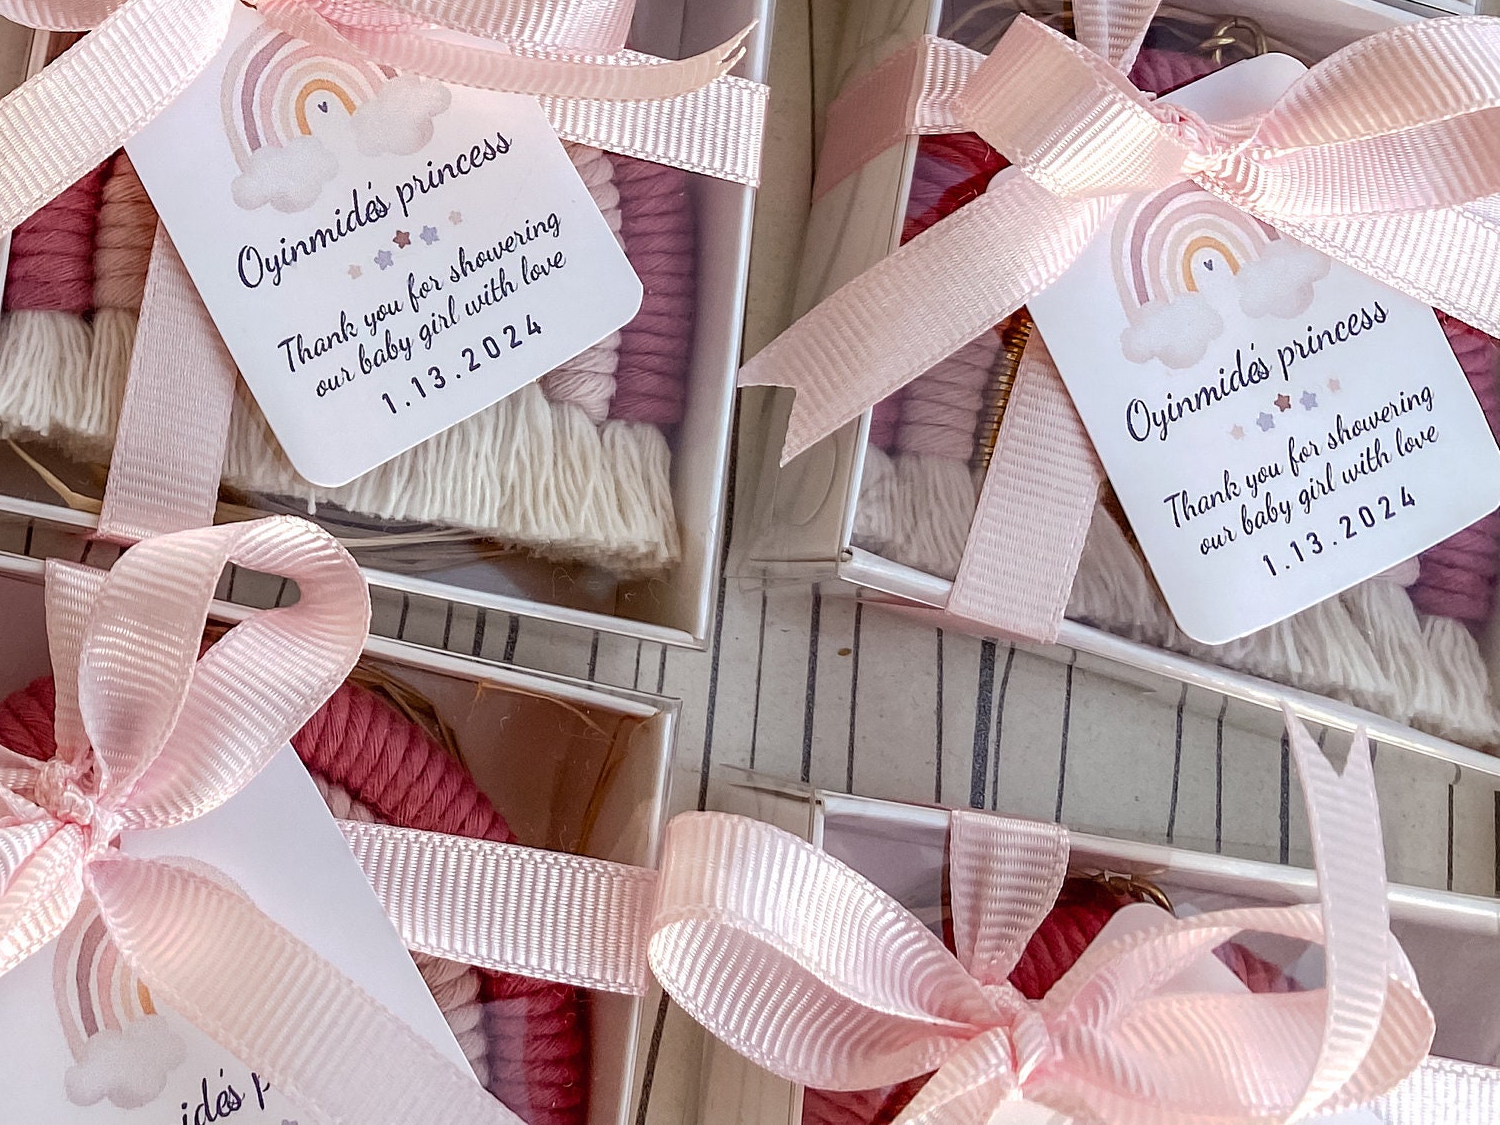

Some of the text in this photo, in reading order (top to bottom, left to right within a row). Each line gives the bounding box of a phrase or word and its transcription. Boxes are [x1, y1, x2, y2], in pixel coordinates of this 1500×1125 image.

[395, 131, 513, 217] princess
[277, 212, 561, 372] Thank you for showering
[316, 251, 567, 397] our baby girl with love
[1276, 302, 1389, 381] princess
[381, 314, 542, 413] 1.13.2024
[1163, 386, 1434, 528] Thank you for showering
[1199, 425, 1439, 554] our baby girl with love
[1262, 486, 1415, 576] 1.13.2024
